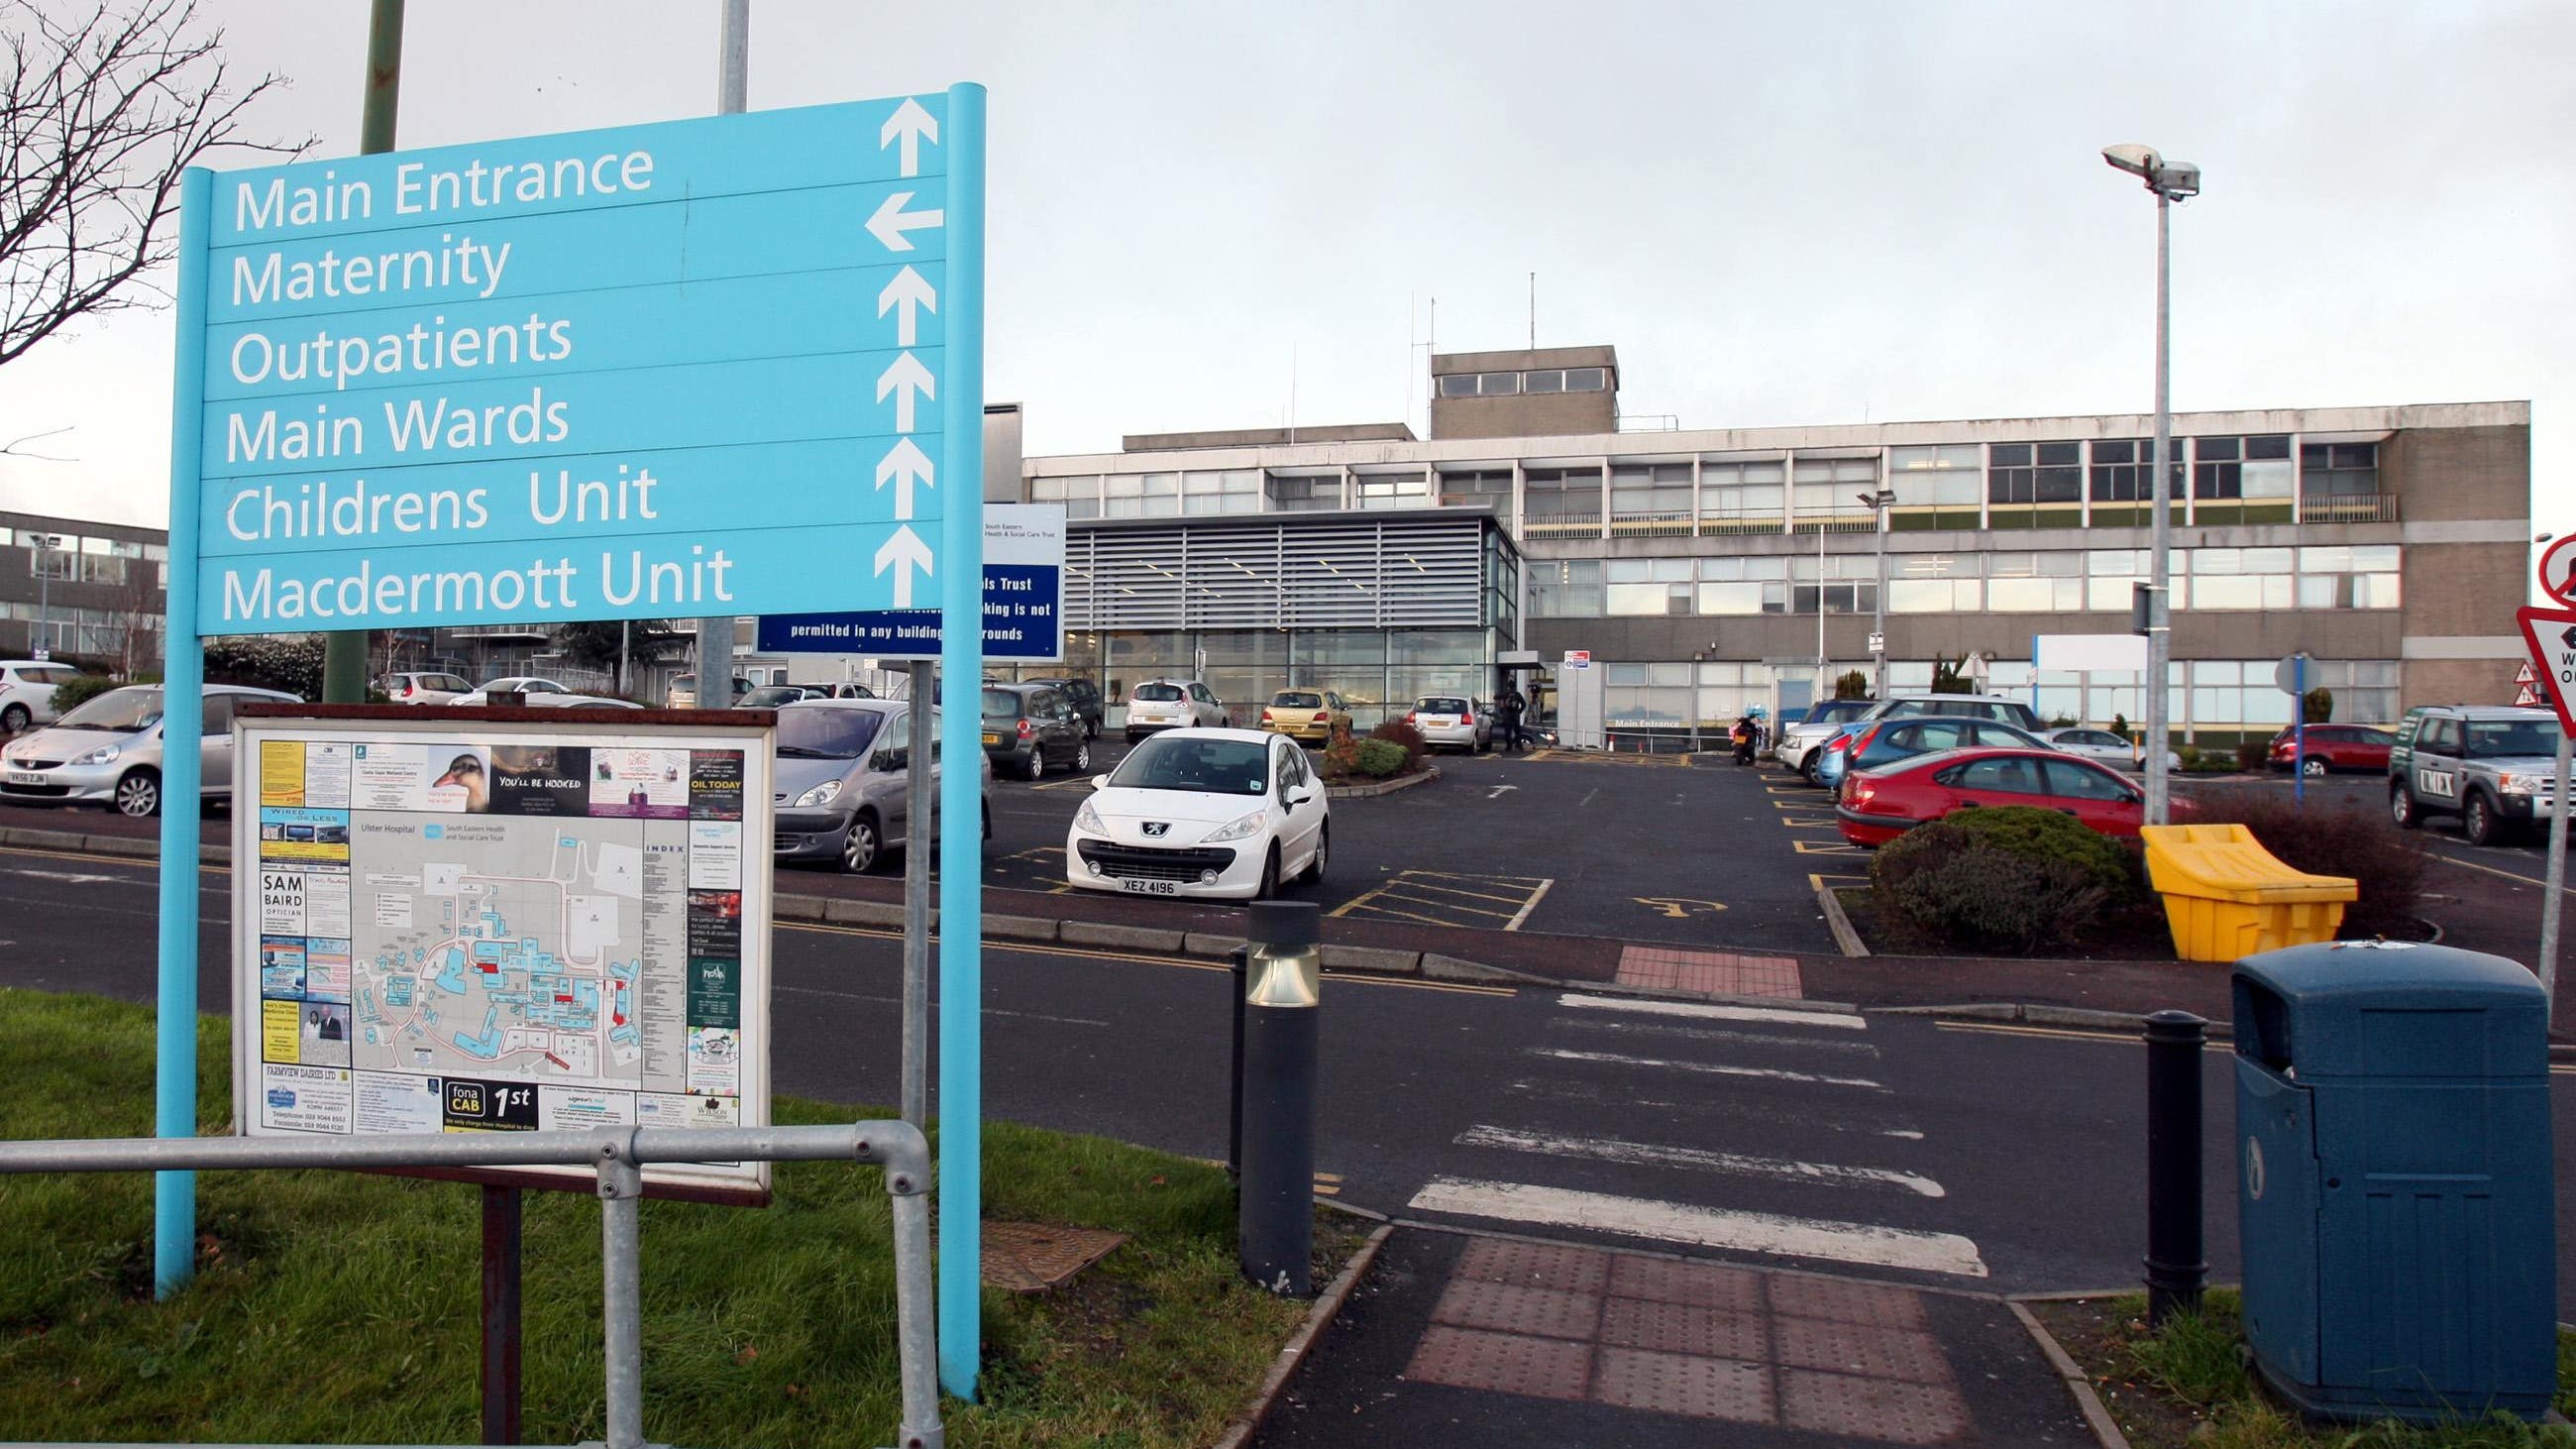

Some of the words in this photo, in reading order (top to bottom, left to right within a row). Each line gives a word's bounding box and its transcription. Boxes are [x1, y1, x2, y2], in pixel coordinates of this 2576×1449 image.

[236, 169, 372, 232] Main
[395, 150, 654, 215] Entrance
[233, 233, 511, 306] Maternity
[231, 312, 572, 391] Outpatients
[227, 403, 363, 464] Main
[383, 386, 570, 452] Wards
[226, 479, 488, 541] Childrens
[530, 464, 658, 525] Unit
[223, 557, 578, 620] Macdermott
[601, 545, 733, 607] Unit
[1001, 578, 1031, 591] Trust
[982, 603, 1010, 617] king
[1016, 603, 1025, 615] is
[1031, 604, 1050, 616] not
[791, 624, 849, 638] permitted
[855, 625, 865, 637] in
[871, 626, 892, 639] any
[982, 627, 1022, 640] rounds
[1640, 720, 1680, 728] Entrance
[531, 779, 543, 788] BE
[545, 779, 582, 789] HOOKED
[691, 780, 707, 789] OIL
[361, 824, 382, 833] Ulster
[384, 825, 415, 835] Hospital
[646, 844, 684, 853] INDEX
[264, 875, 303, 892] SAM
[1124, 880, 1146, 892] XEZ
[1148, 882, 1174, 894] 4196
[265, 895, 302, 907] BAIRD
[325, 1070, 336, 1080] LTD
[452, 1098, 480, 1112] CAB
[453, 1087, 478, 1098] fona
[495, 1088, 530, 1117] 1st
